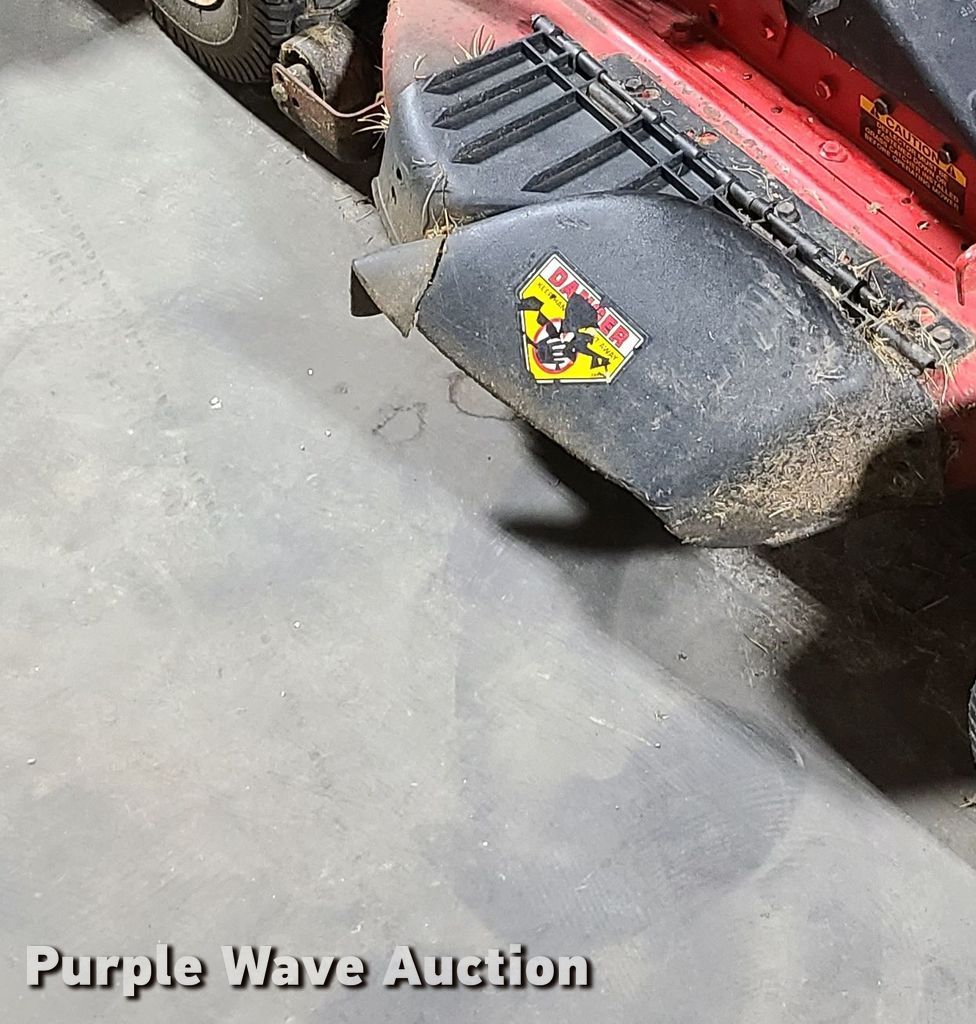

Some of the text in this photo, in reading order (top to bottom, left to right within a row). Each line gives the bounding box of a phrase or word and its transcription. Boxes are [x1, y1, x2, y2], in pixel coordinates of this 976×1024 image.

[876, 122, 916, 156] DEFLECTOR
[918, 154, 937, 172] MUST
[877, 128, 912, 159] FASTENED
[913, 155, 935, 177] DOWN
[886, 117, 939, 163] CAUTION
[864, 127, 959, 203] GRASS CATCHER INSTALLED
[864, 133, 959, 211] BEFORE OPERATING MOWER
[599, 343, 618, 361] AWAY
